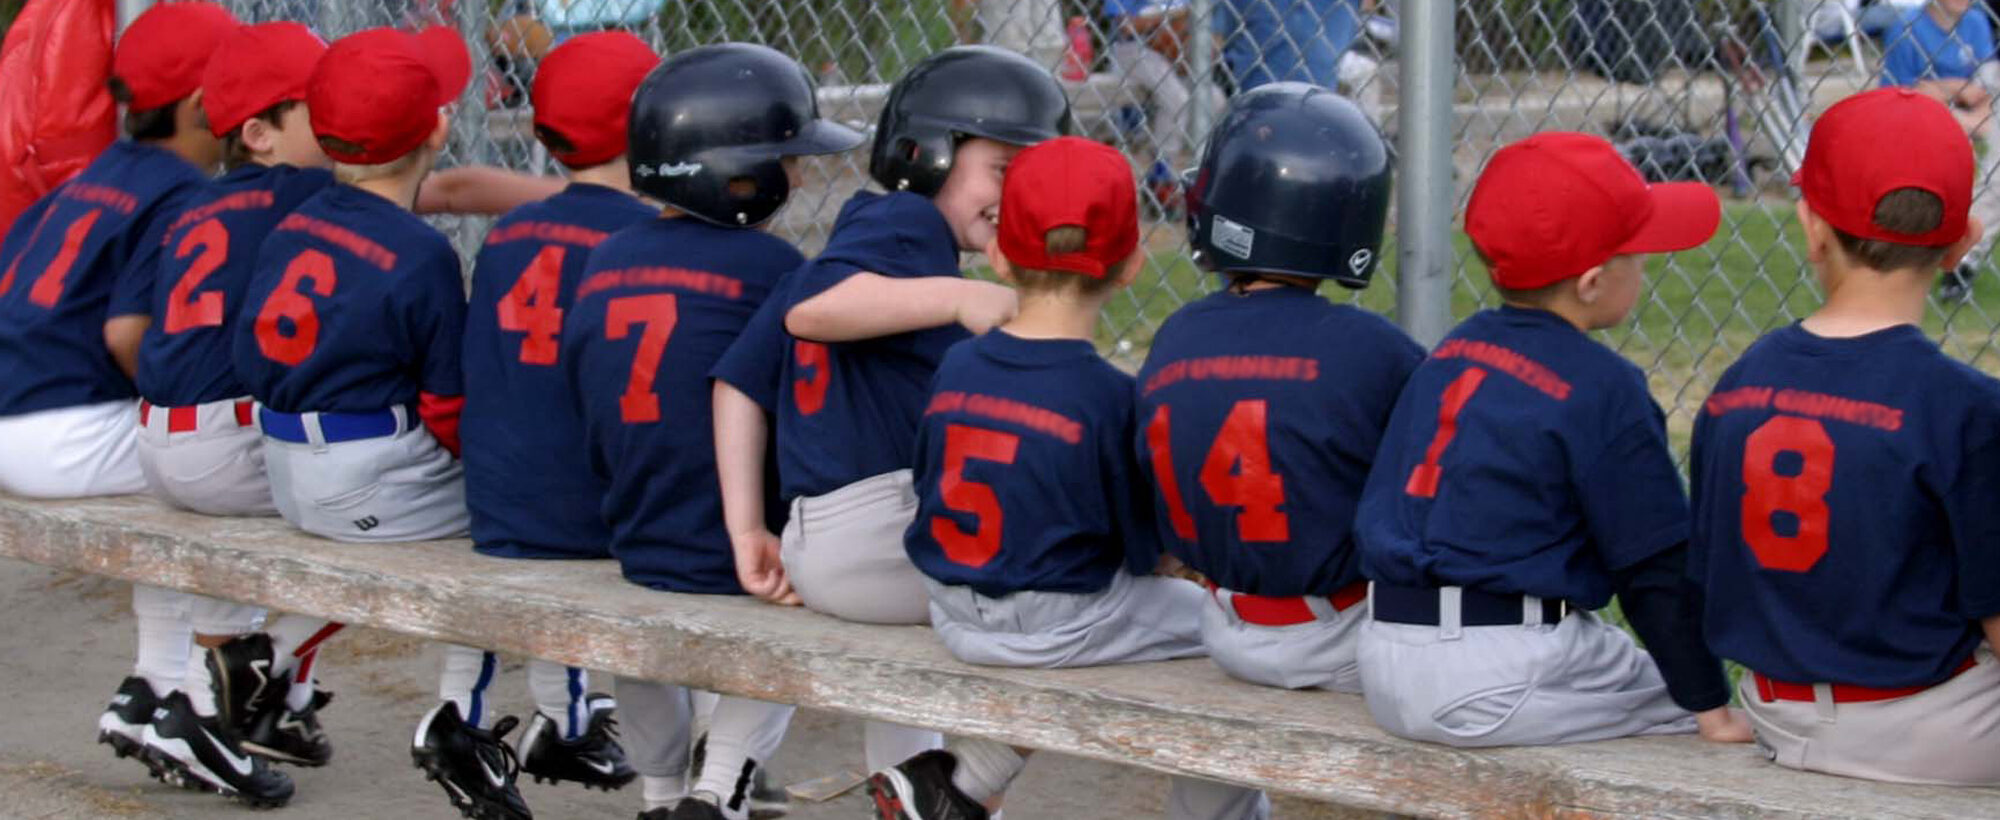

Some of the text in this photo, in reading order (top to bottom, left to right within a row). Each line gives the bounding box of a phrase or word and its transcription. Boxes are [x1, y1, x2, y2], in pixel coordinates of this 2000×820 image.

[164, 217, 230, 335] 2
[254, 248, 337, 366] 6
[497, 244, 566, 366] 4
[605, 292, 678, 423] 7
[931, 423, 1020, 569] 5
[1146, 399, 1290, 542] 14
[1405, 366, 1488, 498] 1
[1741, 414, 1836, 573] 8
